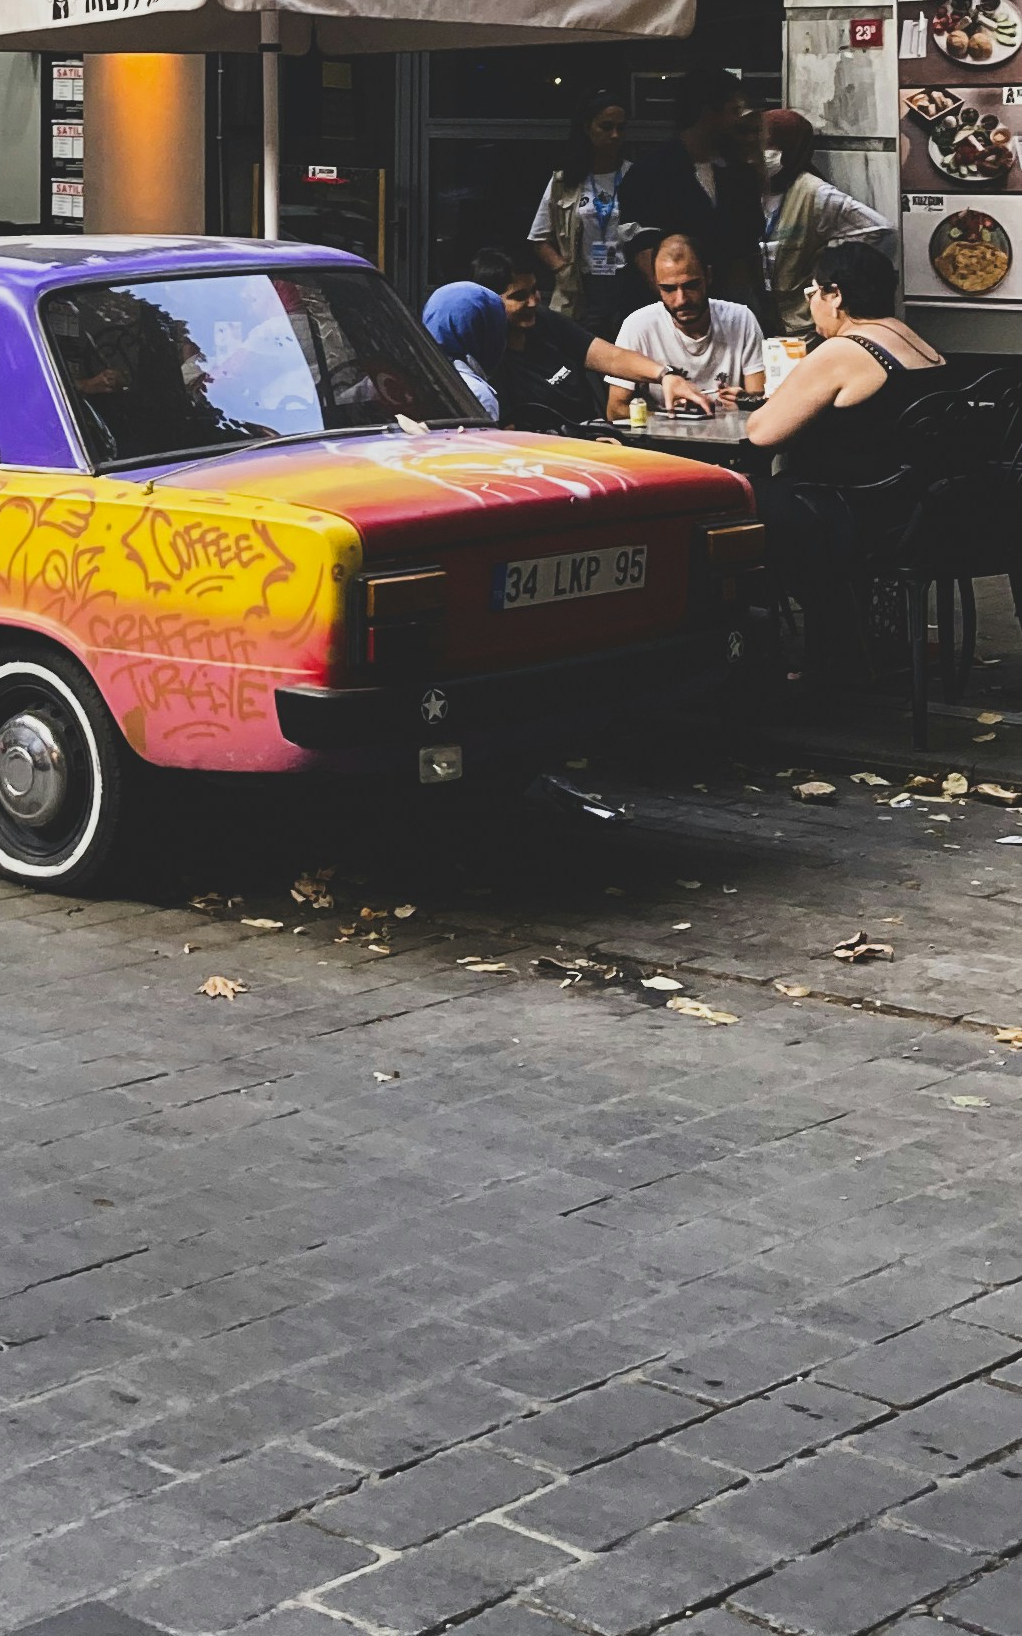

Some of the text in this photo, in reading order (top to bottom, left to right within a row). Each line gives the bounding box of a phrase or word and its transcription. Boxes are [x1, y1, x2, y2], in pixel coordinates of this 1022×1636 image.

[56, 68, 82, 78] SATIL
[56, 126, 82, 136] SATIL
[56, 184, 83, 195] SATIL
[150, 509, 266, 581] COFFEE
[506, 547, 645, 603] 34 LKP 95
